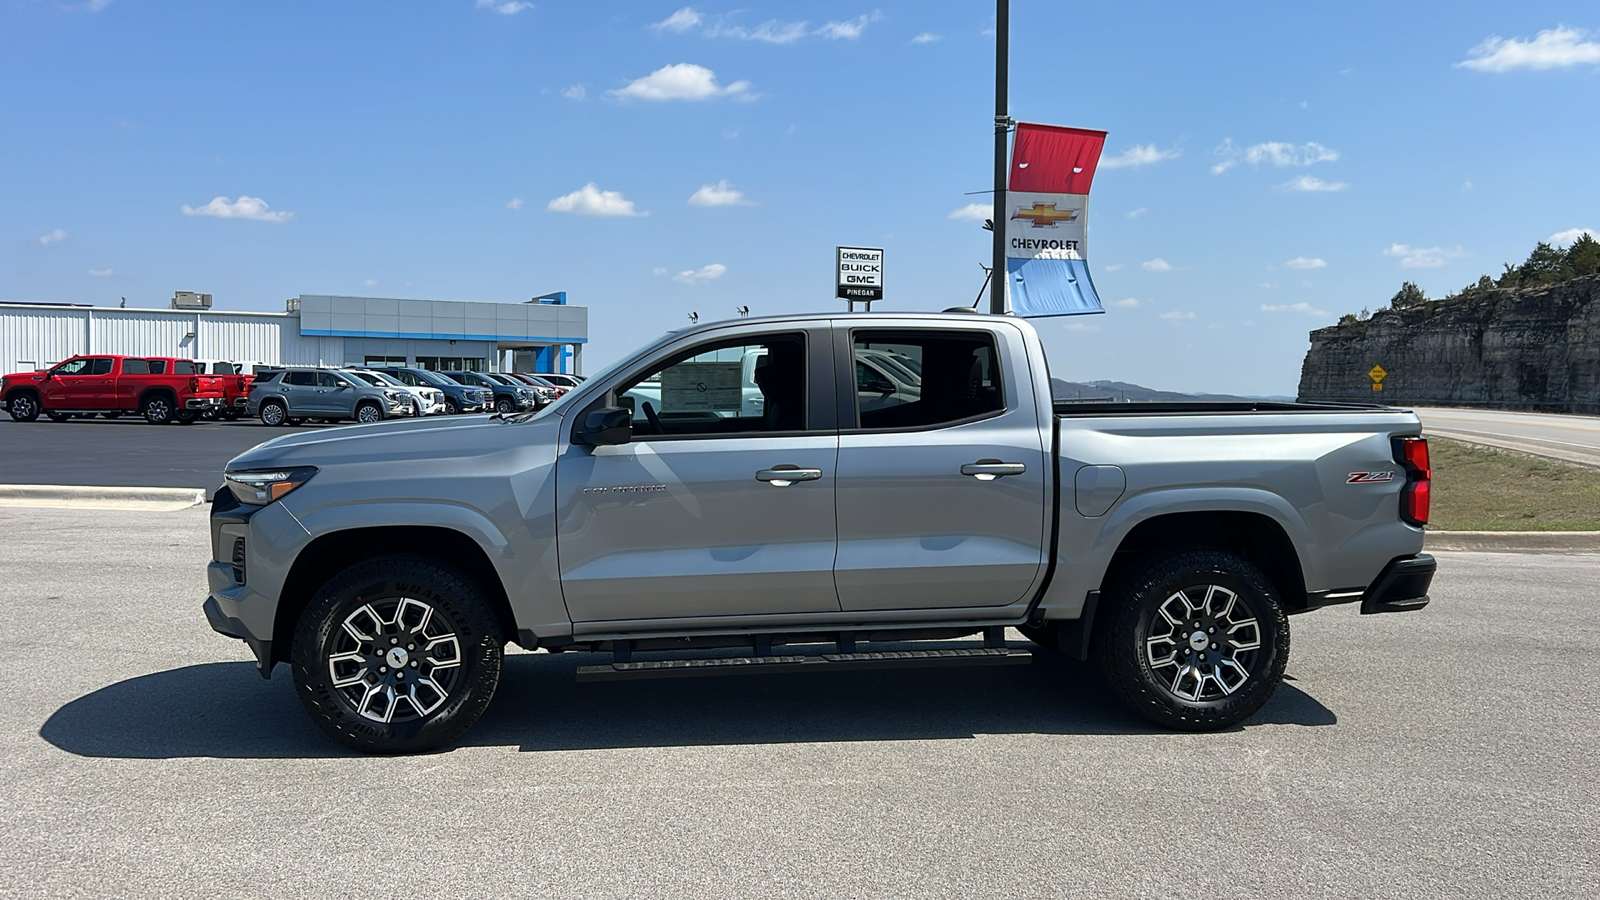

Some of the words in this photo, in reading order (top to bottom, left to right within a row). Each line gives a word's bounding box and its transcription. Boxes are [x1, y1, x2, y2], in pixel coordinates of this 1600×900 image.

[1011, 237, 1079, 251] CHEVROLET
[842, 252, 880, 261] CHEVROLET
[841, 263, 880, 273] BUICK
[846, 275, 875, 284] GMC
[1346, 470, 1395, 485] Z71
[395, 582, 473, 636] WRANGLER
